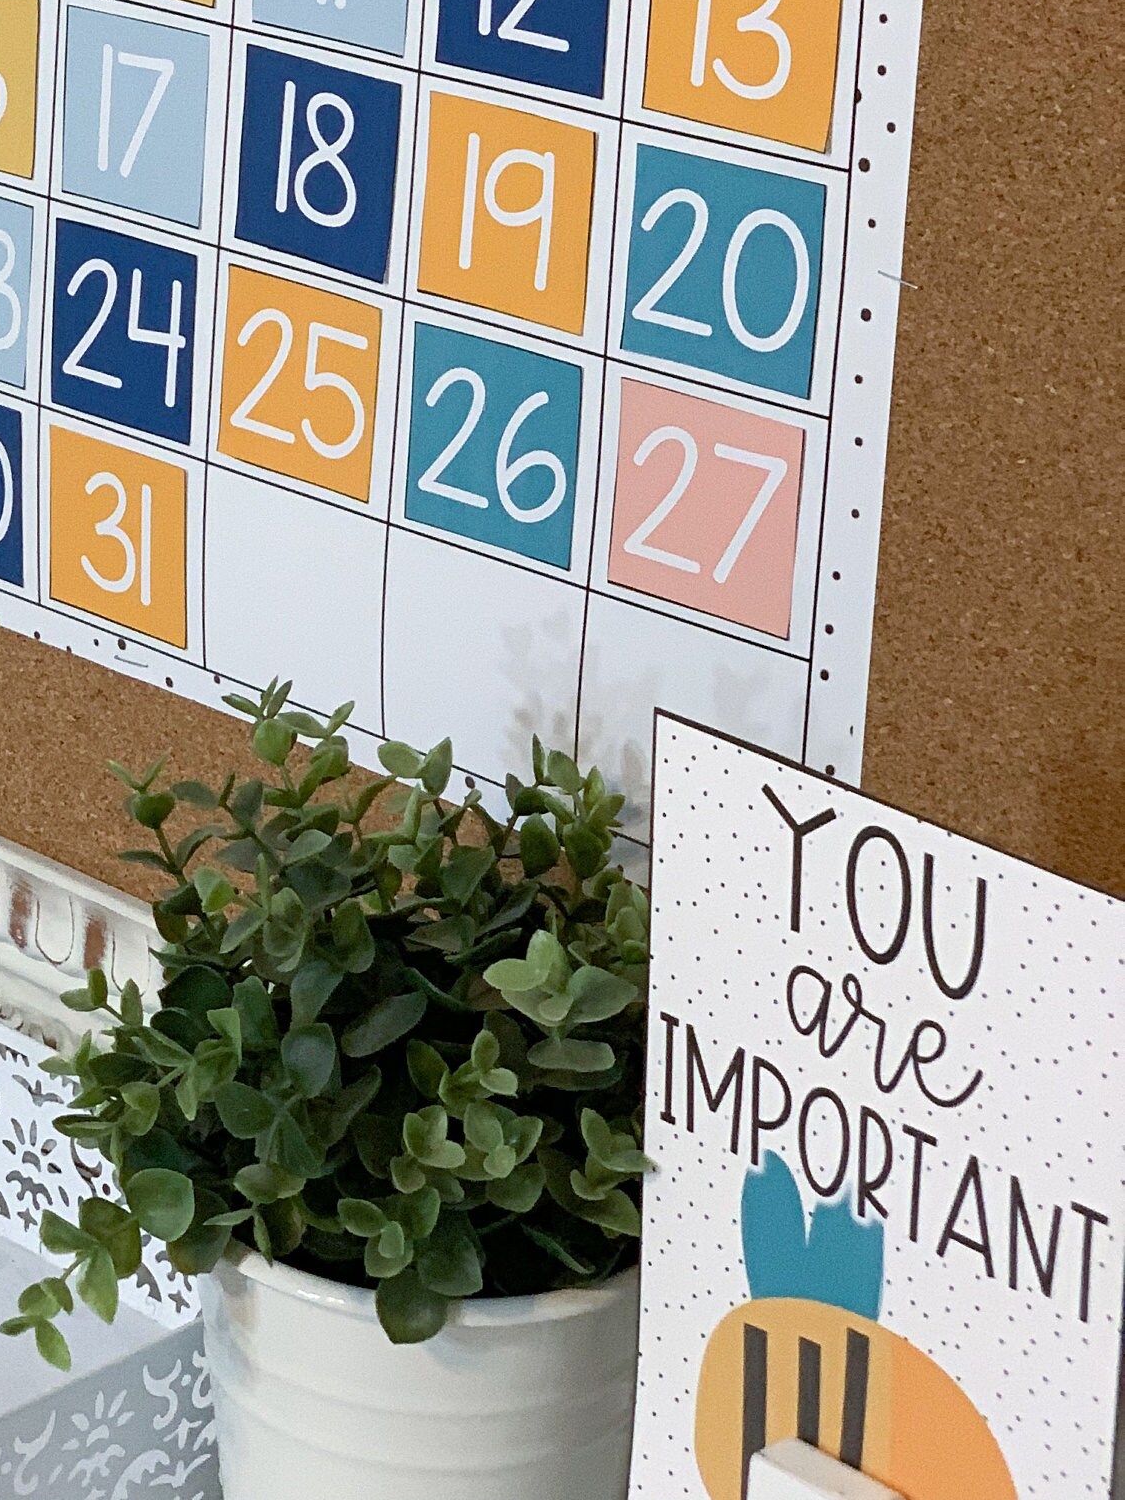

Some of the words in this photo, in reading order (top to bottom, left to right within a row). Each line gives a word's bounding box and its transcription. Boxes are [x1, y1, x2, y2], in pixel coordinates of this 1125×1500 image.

[98, 44, 174, 177] 17
[276, 81, 356, 227] 18
[459, 133, 555, 291] 19
[632, 189, 809, 352] 20
[63, 259, 186, 407] 24
[230, 308, 368, 459] 25
[418, 367, 566, 523] 26
[624, 426, 787, 583] 27
[81, 472, 151, 606] 31
[761, 783, 987, 1000] YOU
[660, 1011, 1109, 1323] IMPORTANT
[786, 964, 983, 1108] are
